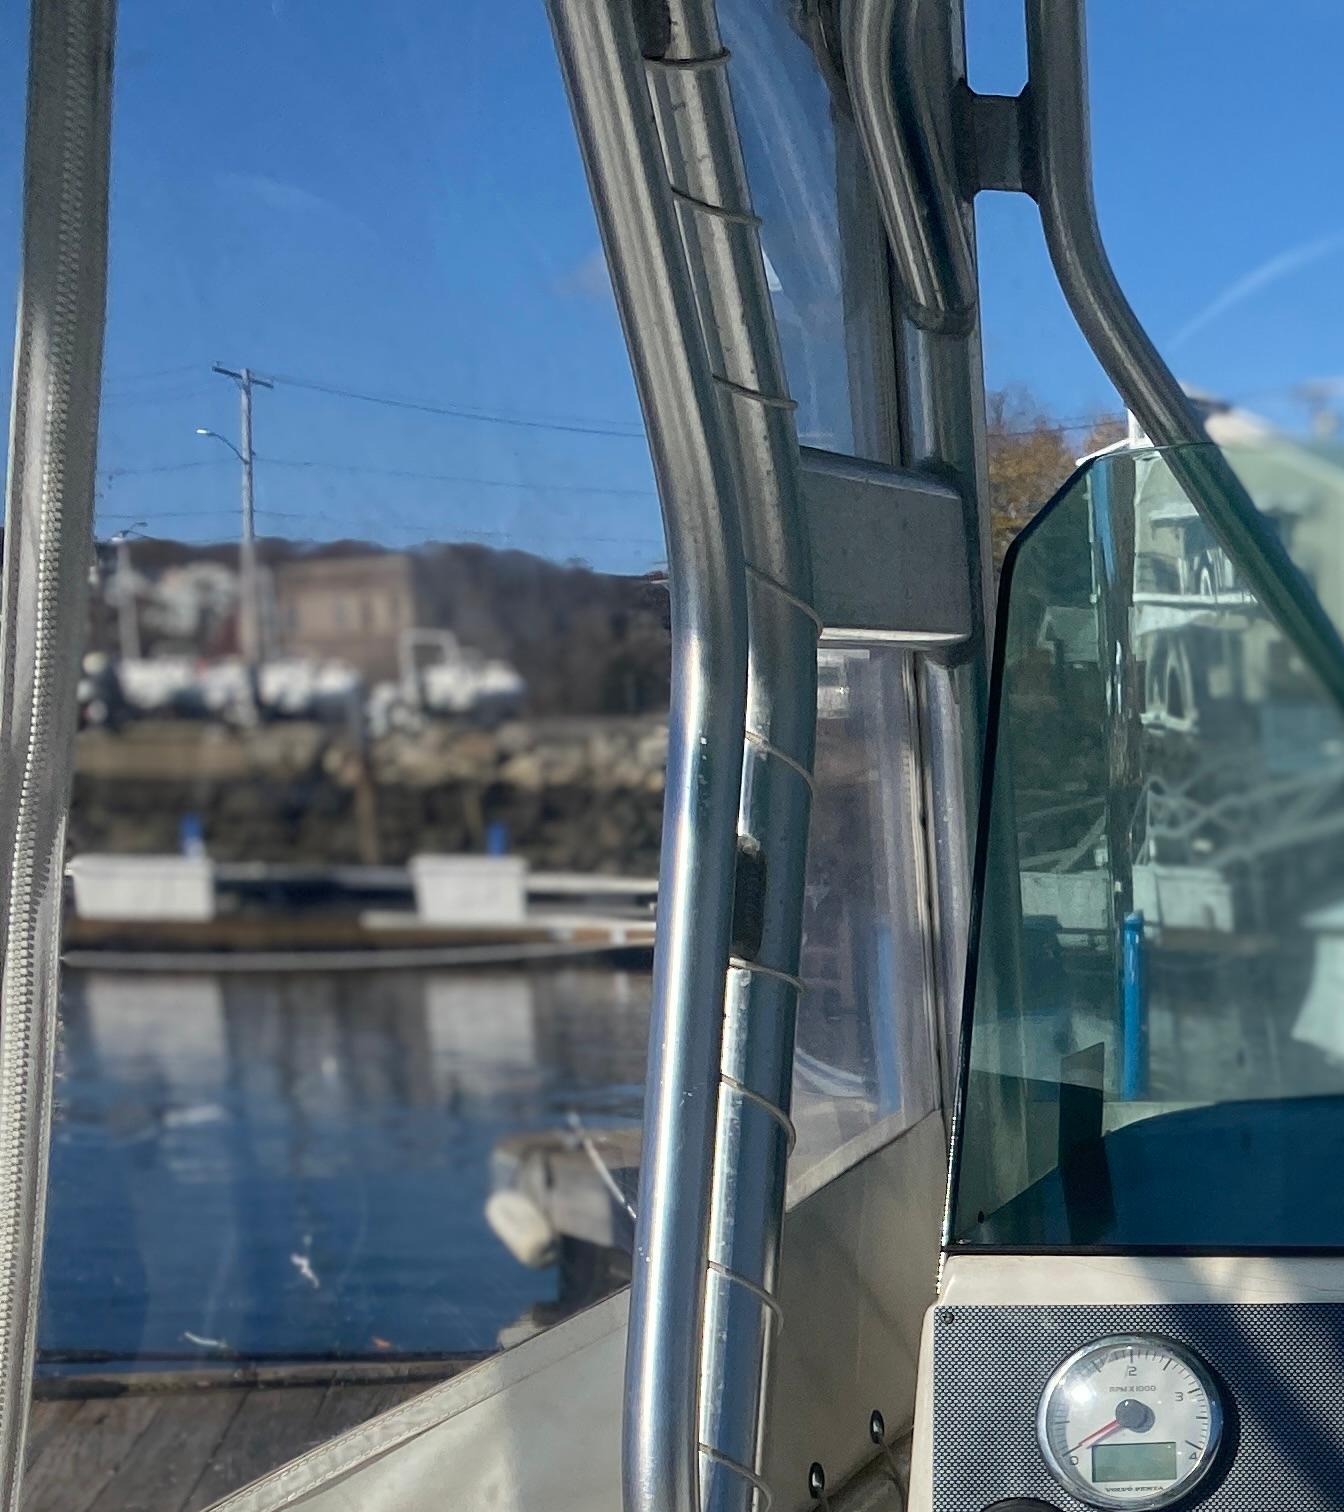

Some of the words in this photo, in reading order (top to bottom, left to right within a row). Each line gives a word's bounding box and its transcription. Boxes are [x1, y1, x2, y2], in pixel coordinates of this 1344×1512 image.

[1127, 1366, 1137, 1377] 2
[1174, 1391, 1184, 1402] 3
[1188, 1451, 1198, 1460] 4
